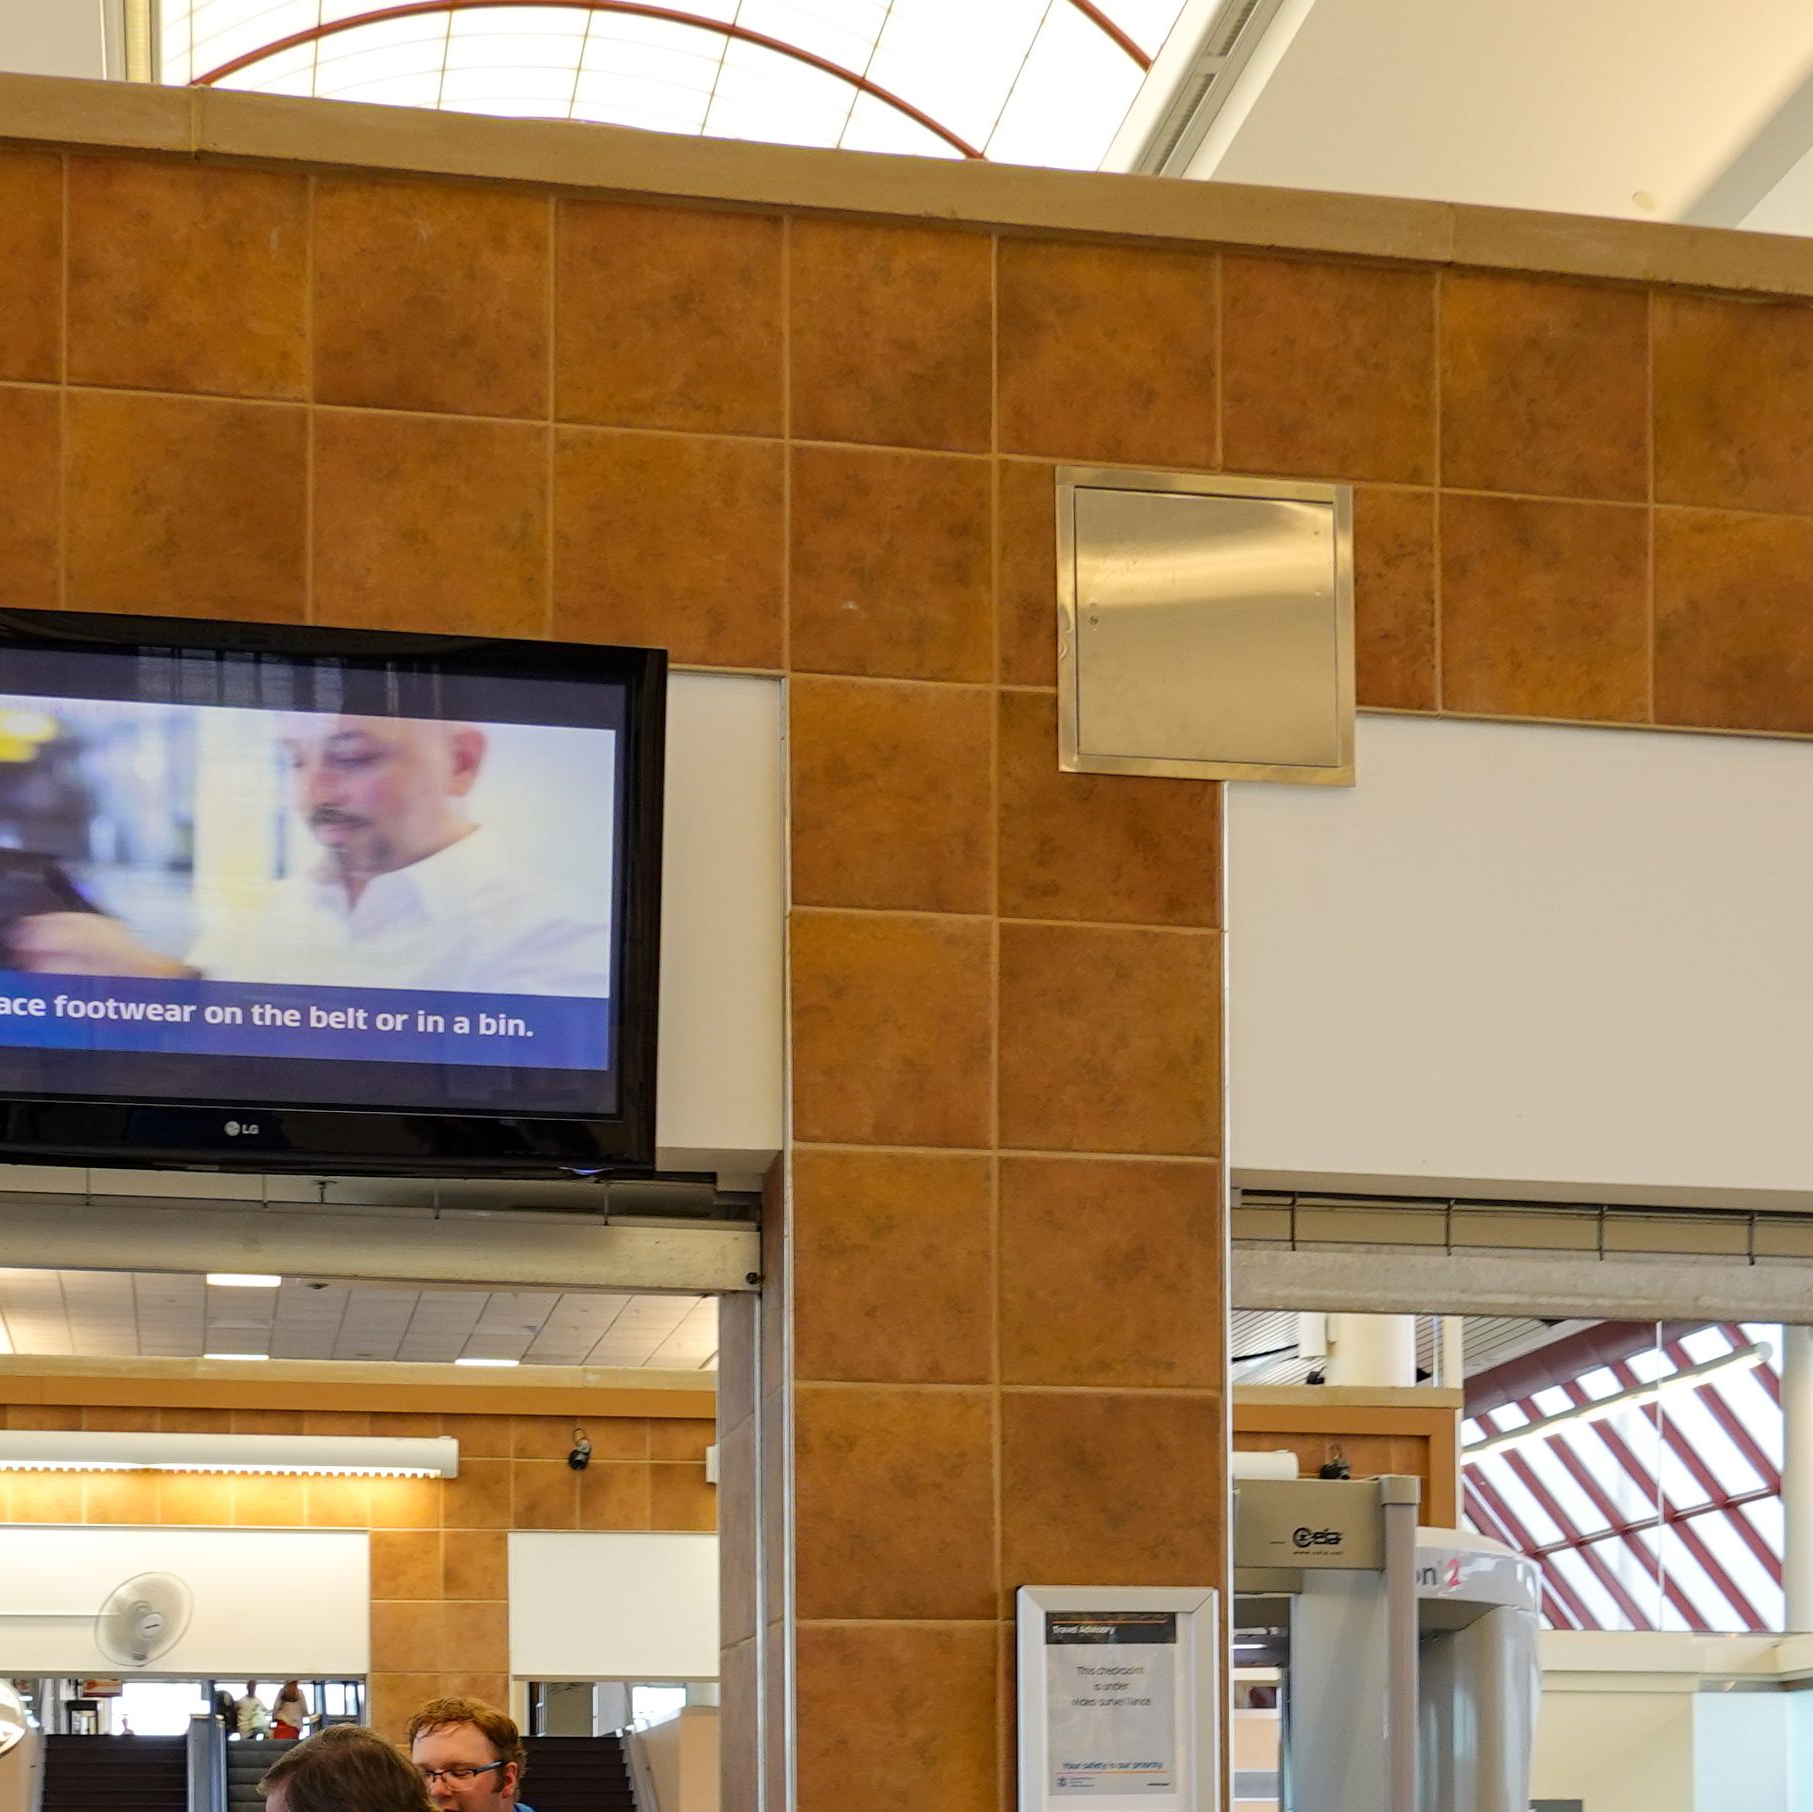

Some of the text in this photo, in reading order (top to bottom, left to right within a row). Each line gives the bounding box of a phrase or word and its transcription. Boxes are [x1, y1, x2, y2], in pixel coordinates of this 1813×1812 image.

[53, 993, 197, 1023] footwear
[205, 1004, 243, 1024] on
[251, 1001, 301, 1028] the
[309, 1005, 367, 1032] belt
[376, 1012, 407, 1032] or
[417, 1010, 444, 1034] in
[453, 1016, 470, 1036] a
[478, 1012, 534, 1038] bin.
[241, 1123, 259, 1135] LG
[1446, 1558, 1461, 1587] 2
